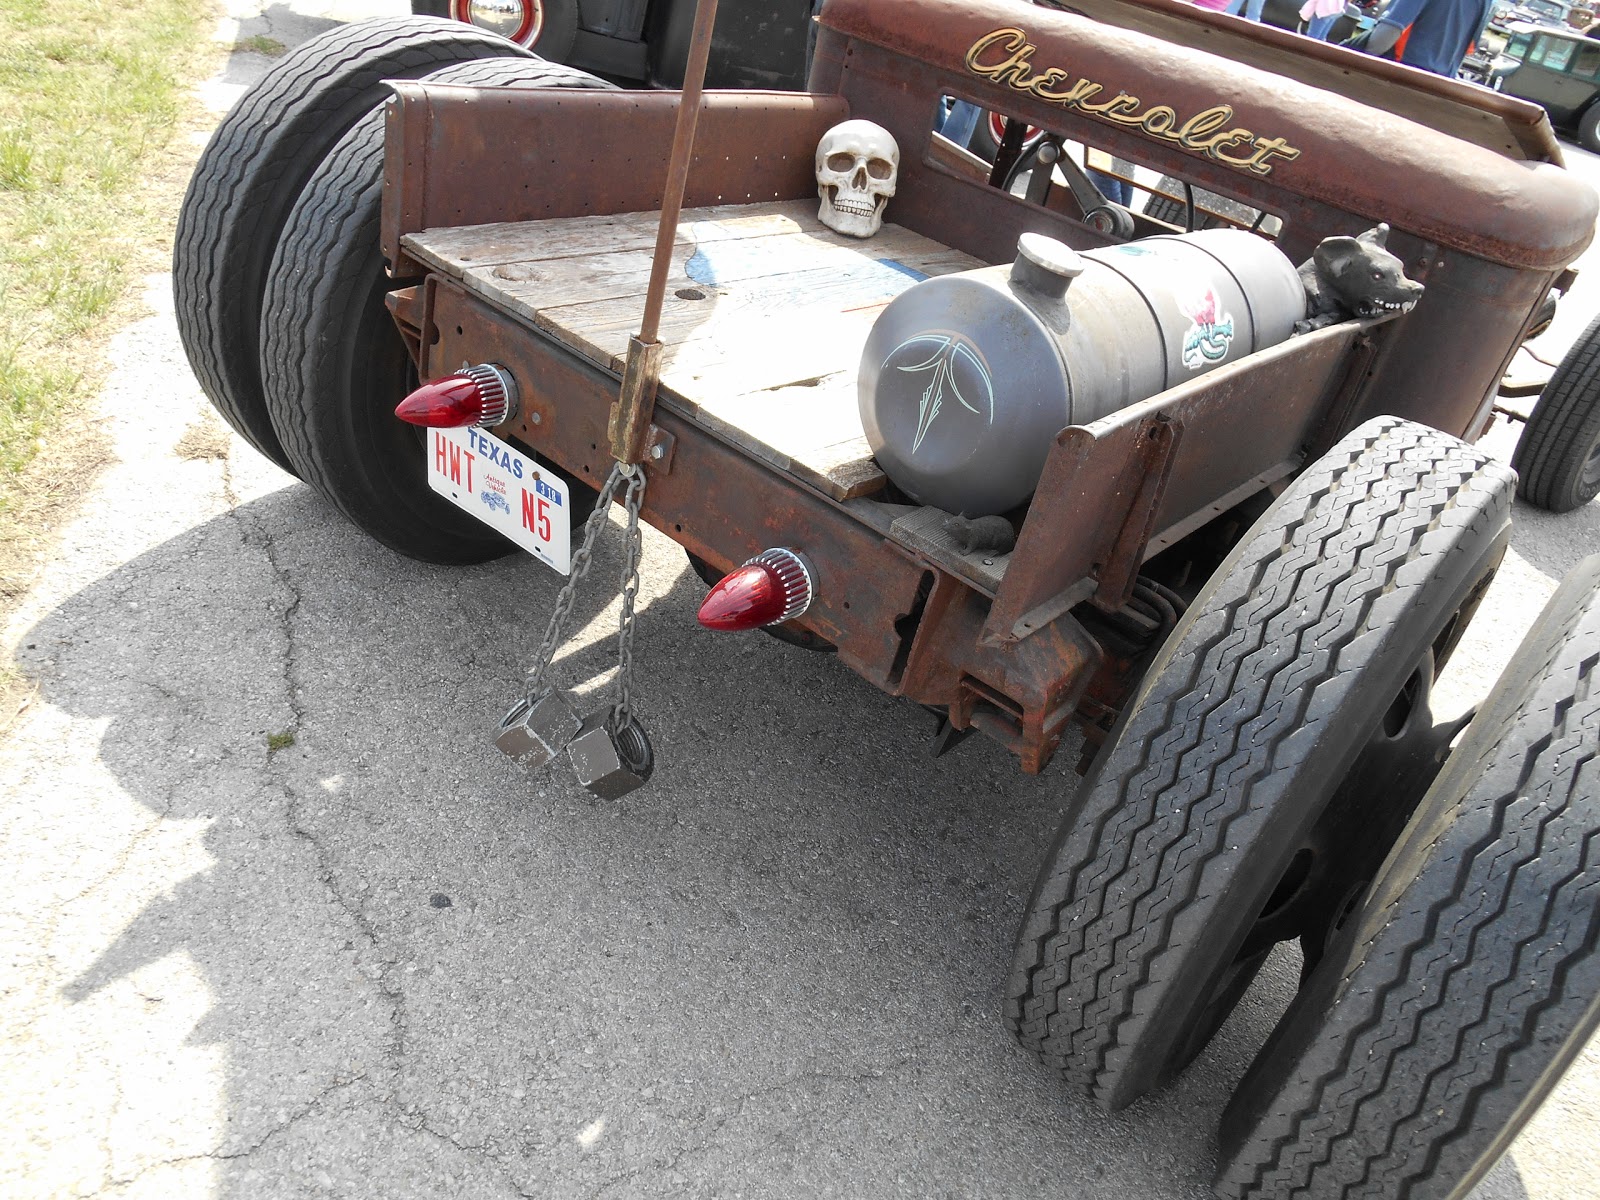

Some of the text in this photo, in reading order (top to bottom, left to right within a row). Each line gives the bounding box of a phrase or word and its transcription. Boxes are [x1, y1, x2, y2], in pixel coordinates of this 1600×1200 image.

[965, 27, 1300, 175] Chevrolet
[435, 431, 551, 542] HWT N5
[467, 428, 523, 479] TEXAS
